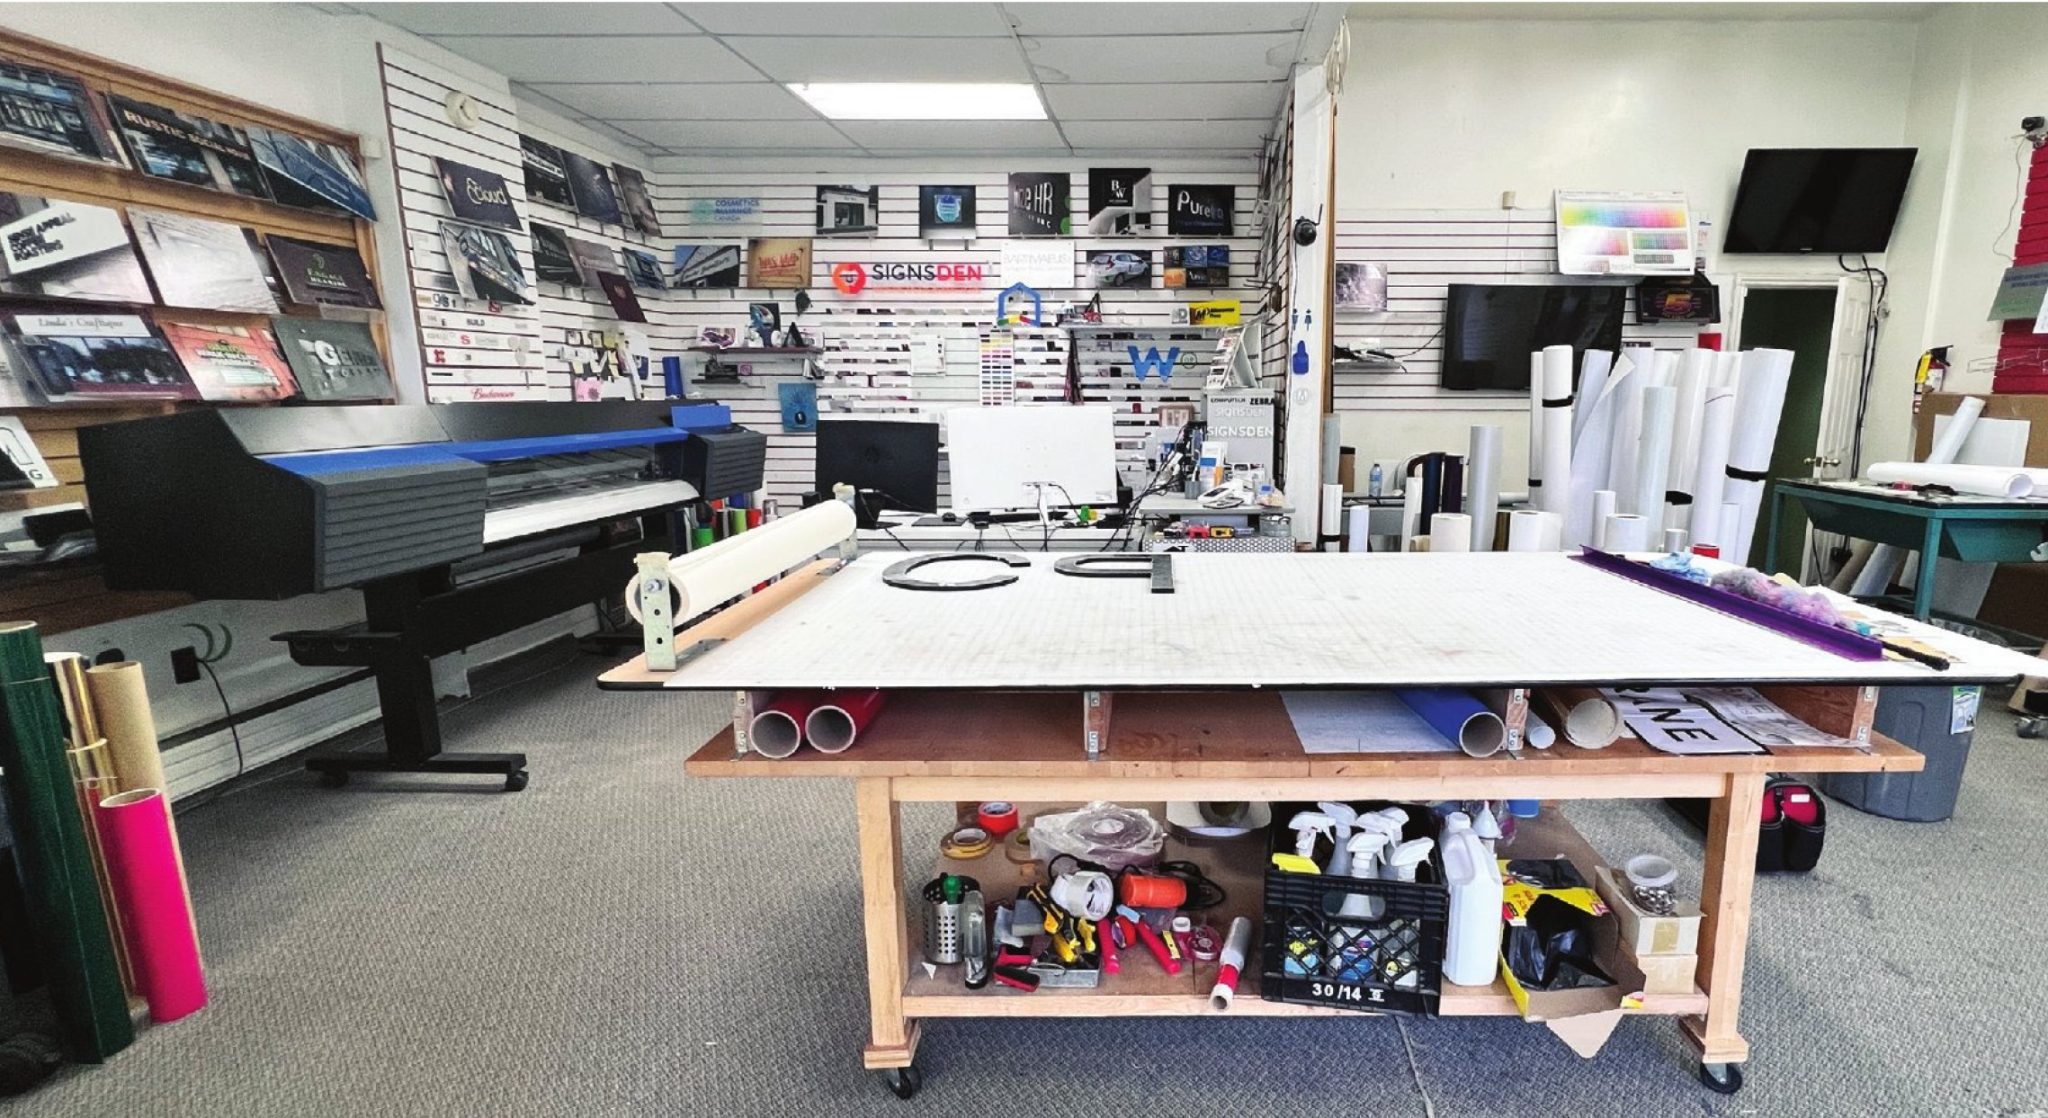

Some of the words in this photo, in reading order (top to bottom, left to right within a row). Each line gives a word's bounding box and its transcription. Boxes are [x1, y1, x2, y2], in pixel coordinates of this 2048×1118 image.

[123, 108, 188, 140] RUSTIC
[1111, 179, 1120, 192] B
[715, 199, 760, 207] COSMETICS
[872, 263, 983, 281] SIGNSDEN
[466, 318, 486, 327] BUILD
[1127, 345, 1181, 383] W
[1206, 425, 1274, 437] SIGNSDEN
